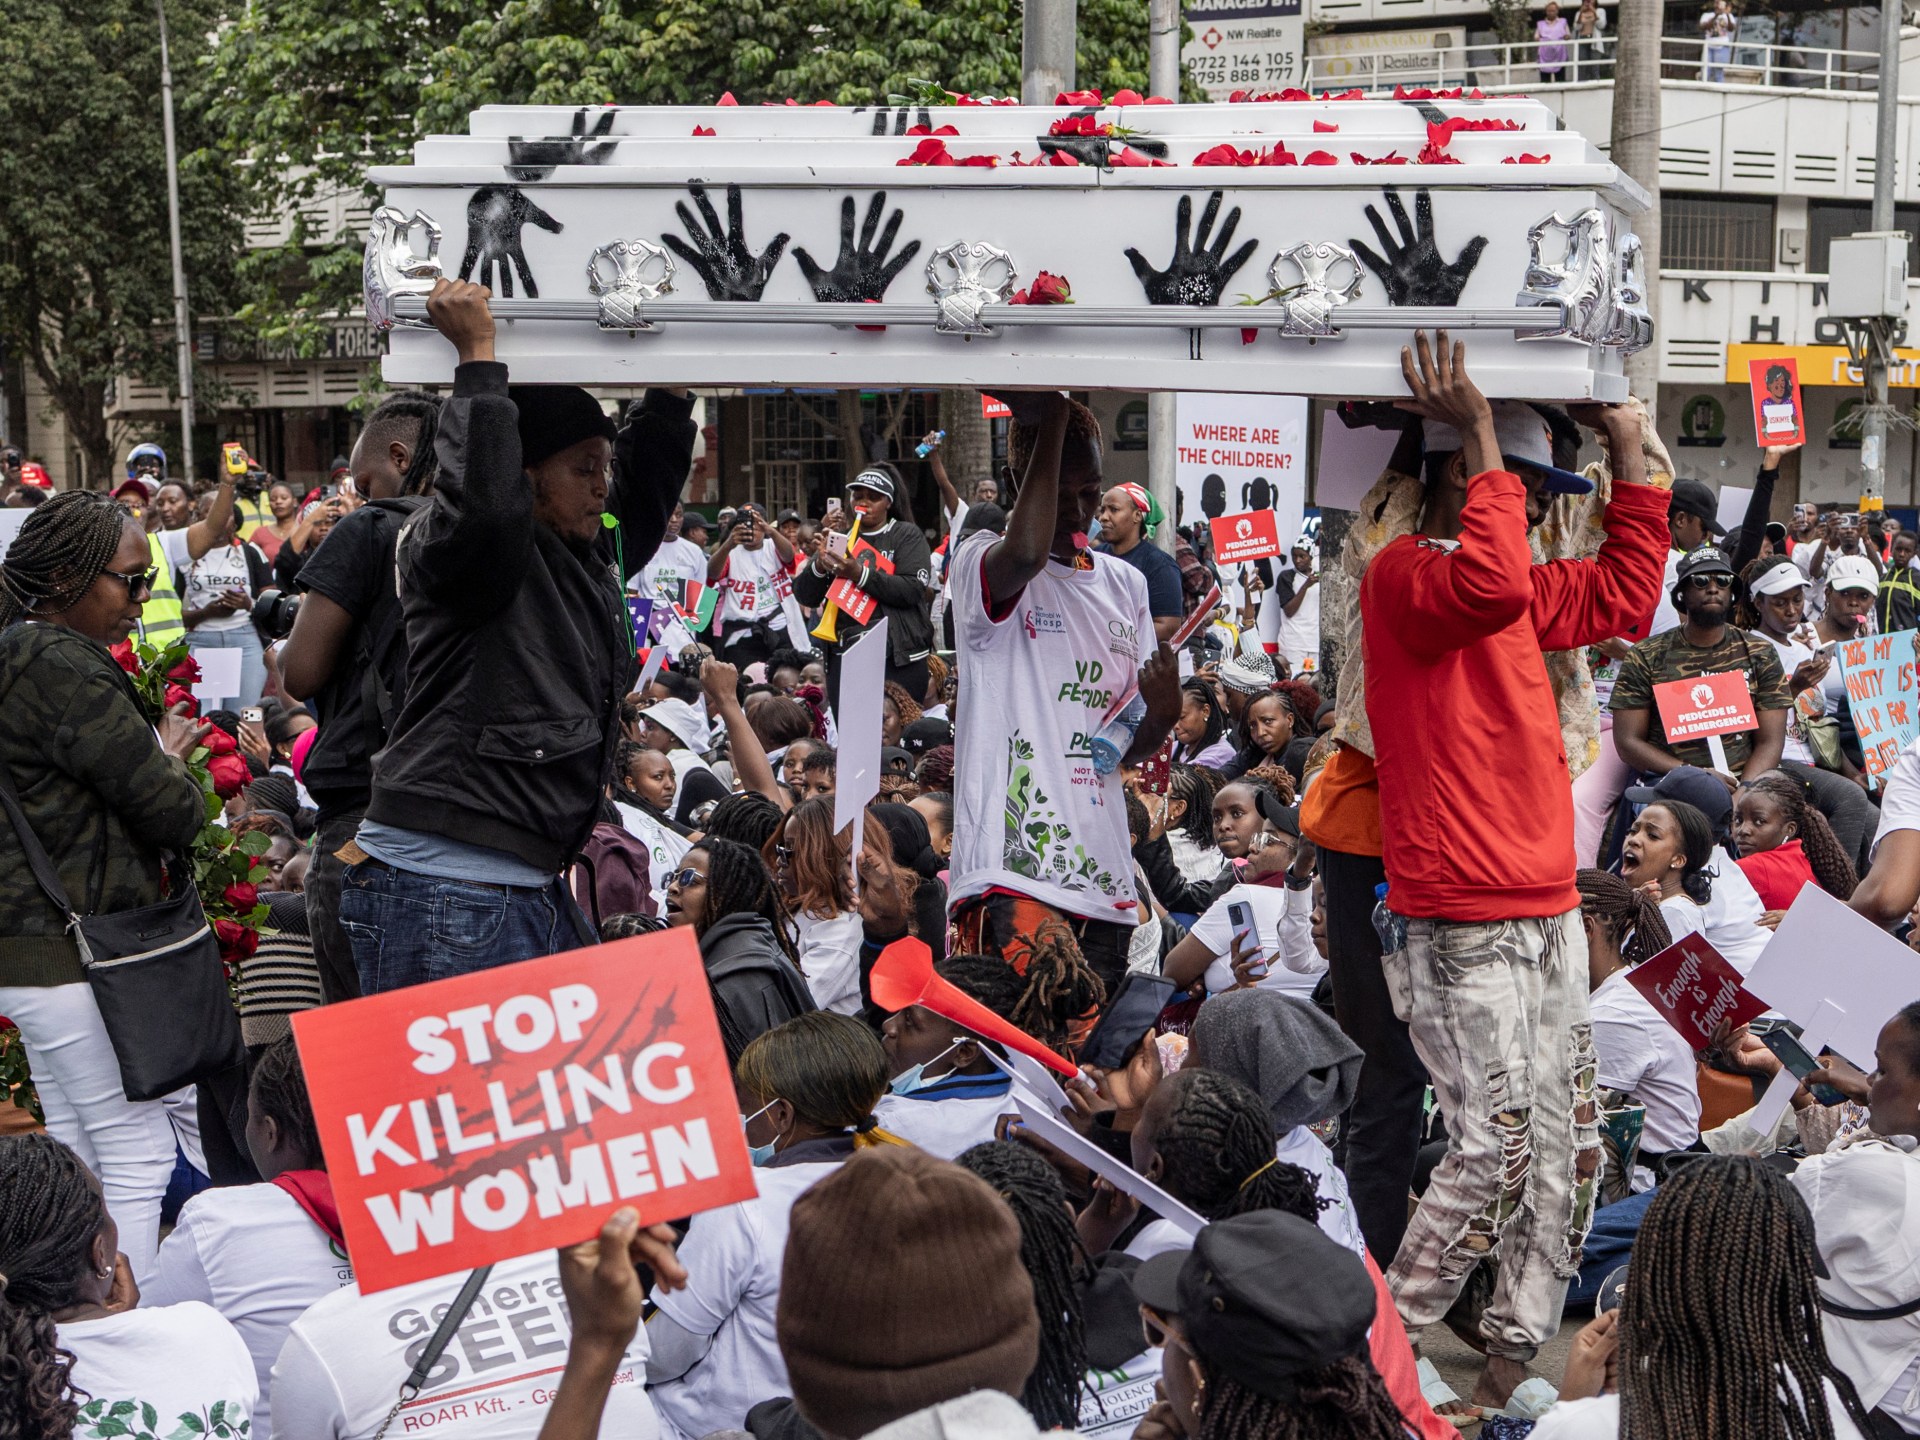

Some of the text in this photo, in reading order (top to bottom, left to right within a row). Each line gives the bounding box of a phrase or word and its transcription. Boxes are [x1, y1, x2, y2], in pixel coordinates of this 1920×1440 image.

[1227, 28, 1282, 39] NW Realite
[1188, 52, 1293, 69] 0722 144 105
[1383, 53, 1429, 69] Realite
[1230, 69, 1259, 83] 888
[1265, 67, 1293, 80] 777
[1193, 424, 1280, 445] WHERE ARE
[1178, 447, 1292, 469] THE CHILDREN?
[1220, 544, 1277, 560] AN EMERGENCY
[1226, 537, 1268, 550] PEDICIDE IS
[204, 574, 247, 585] Tezos
[658, 568, 676, 576] END
[1873, 636, 1893, 660] MY
[1897, 662, 1913, 692] IS
[1678, 705, 1737, 723] PEDICIDE IS
[1670, 715, 1751, 737] AN EMERGENCY
[1074, 767, 1091, 776] NOT
[1656, 948, 1702, 1010] Enough
[1687, 985, 1707, 1005] is
[1691, 975, 1739, 1038] Enough
[407, 983, 598, 1075] STOP
[345, 1040, 695, 1176] KILLING
[364, 1117, 720, 1256] WOMEN
[404, 1302, 574, 1390] SEE
[403, 1402, 468, 1433] ROAR
[475, 1396, 511, 1419] Kft.
